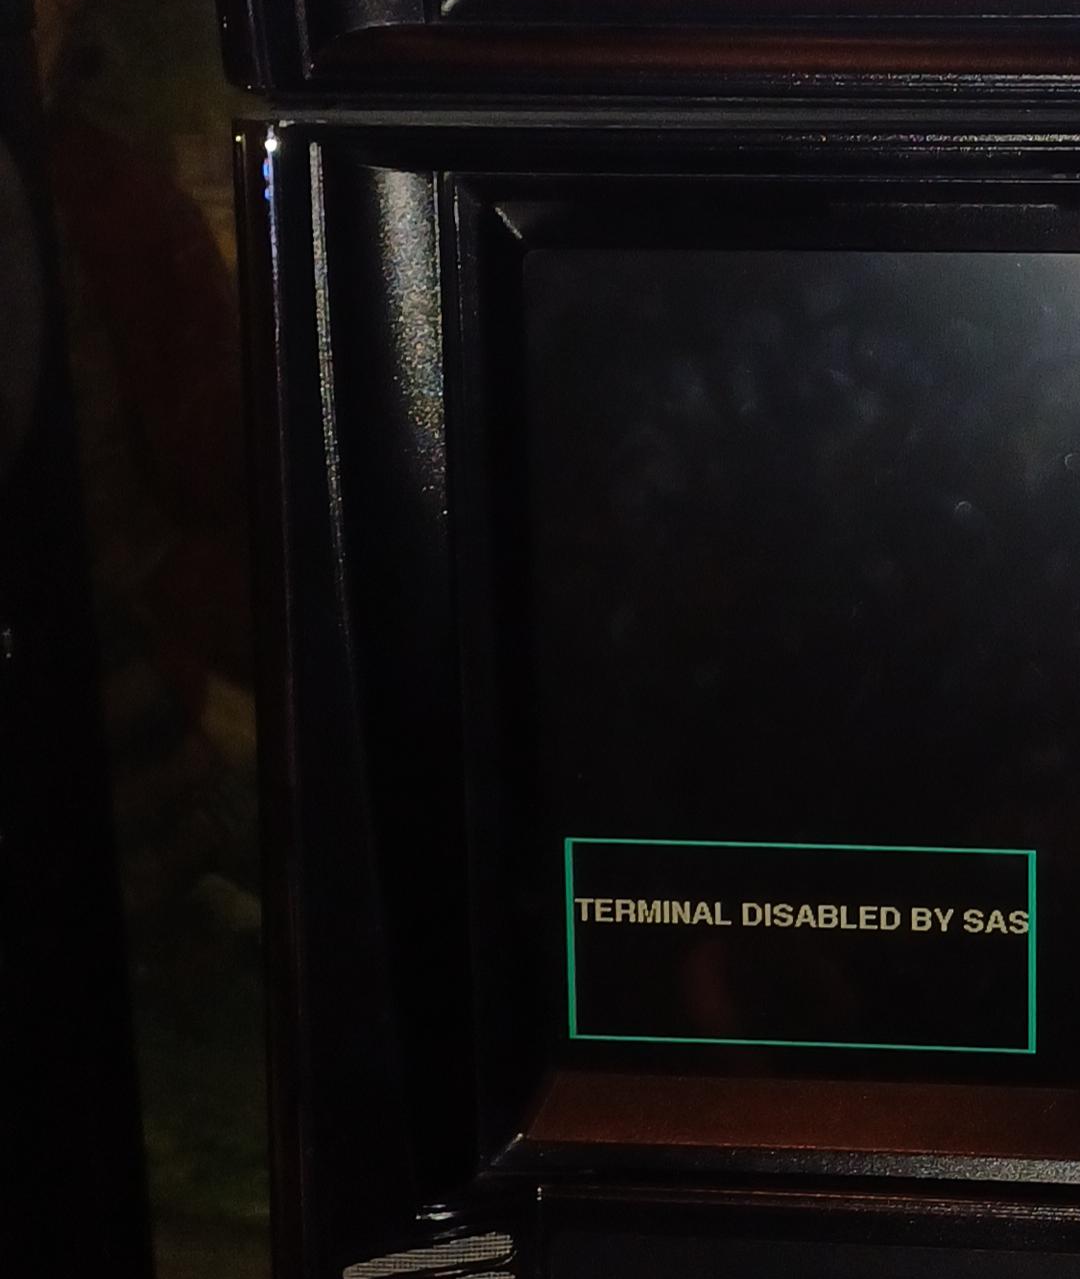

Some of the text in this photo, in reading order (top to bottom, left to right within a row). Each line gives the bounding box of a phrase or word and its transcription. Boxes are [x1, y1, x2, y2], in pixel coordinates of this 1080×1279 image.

[574, 898, 1030, 935] TERMINAL DISABLED BY SAS
